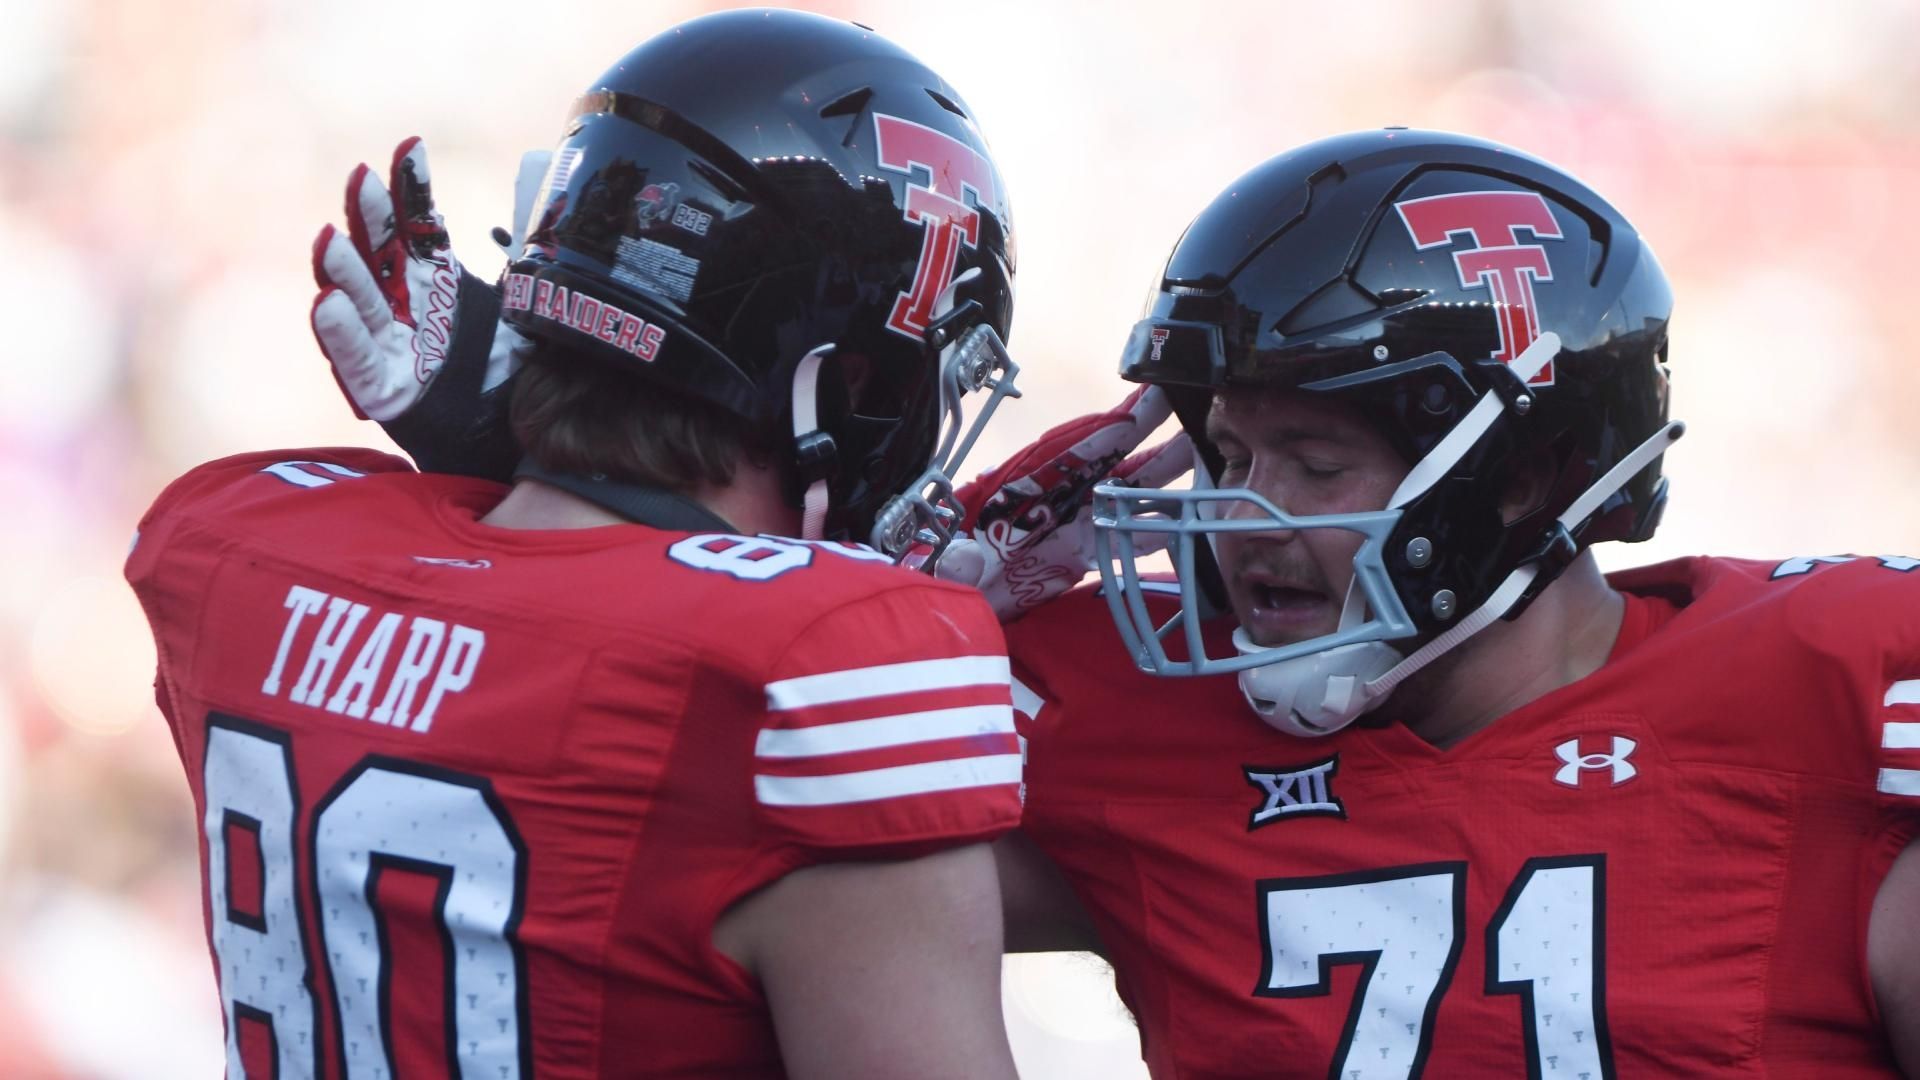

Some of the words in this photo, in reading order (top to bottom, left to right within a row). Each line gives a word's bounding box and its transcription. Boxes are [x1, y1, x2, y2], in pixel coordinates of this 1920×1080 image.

[534, 278, 667, 362] RAIDERS
[261, 584, 486, 734] THARP
[1246, 757, 1344, 825] XII
[203, 711, 537, 1080] 80
[1252, 852, 1618, 1080] 71
